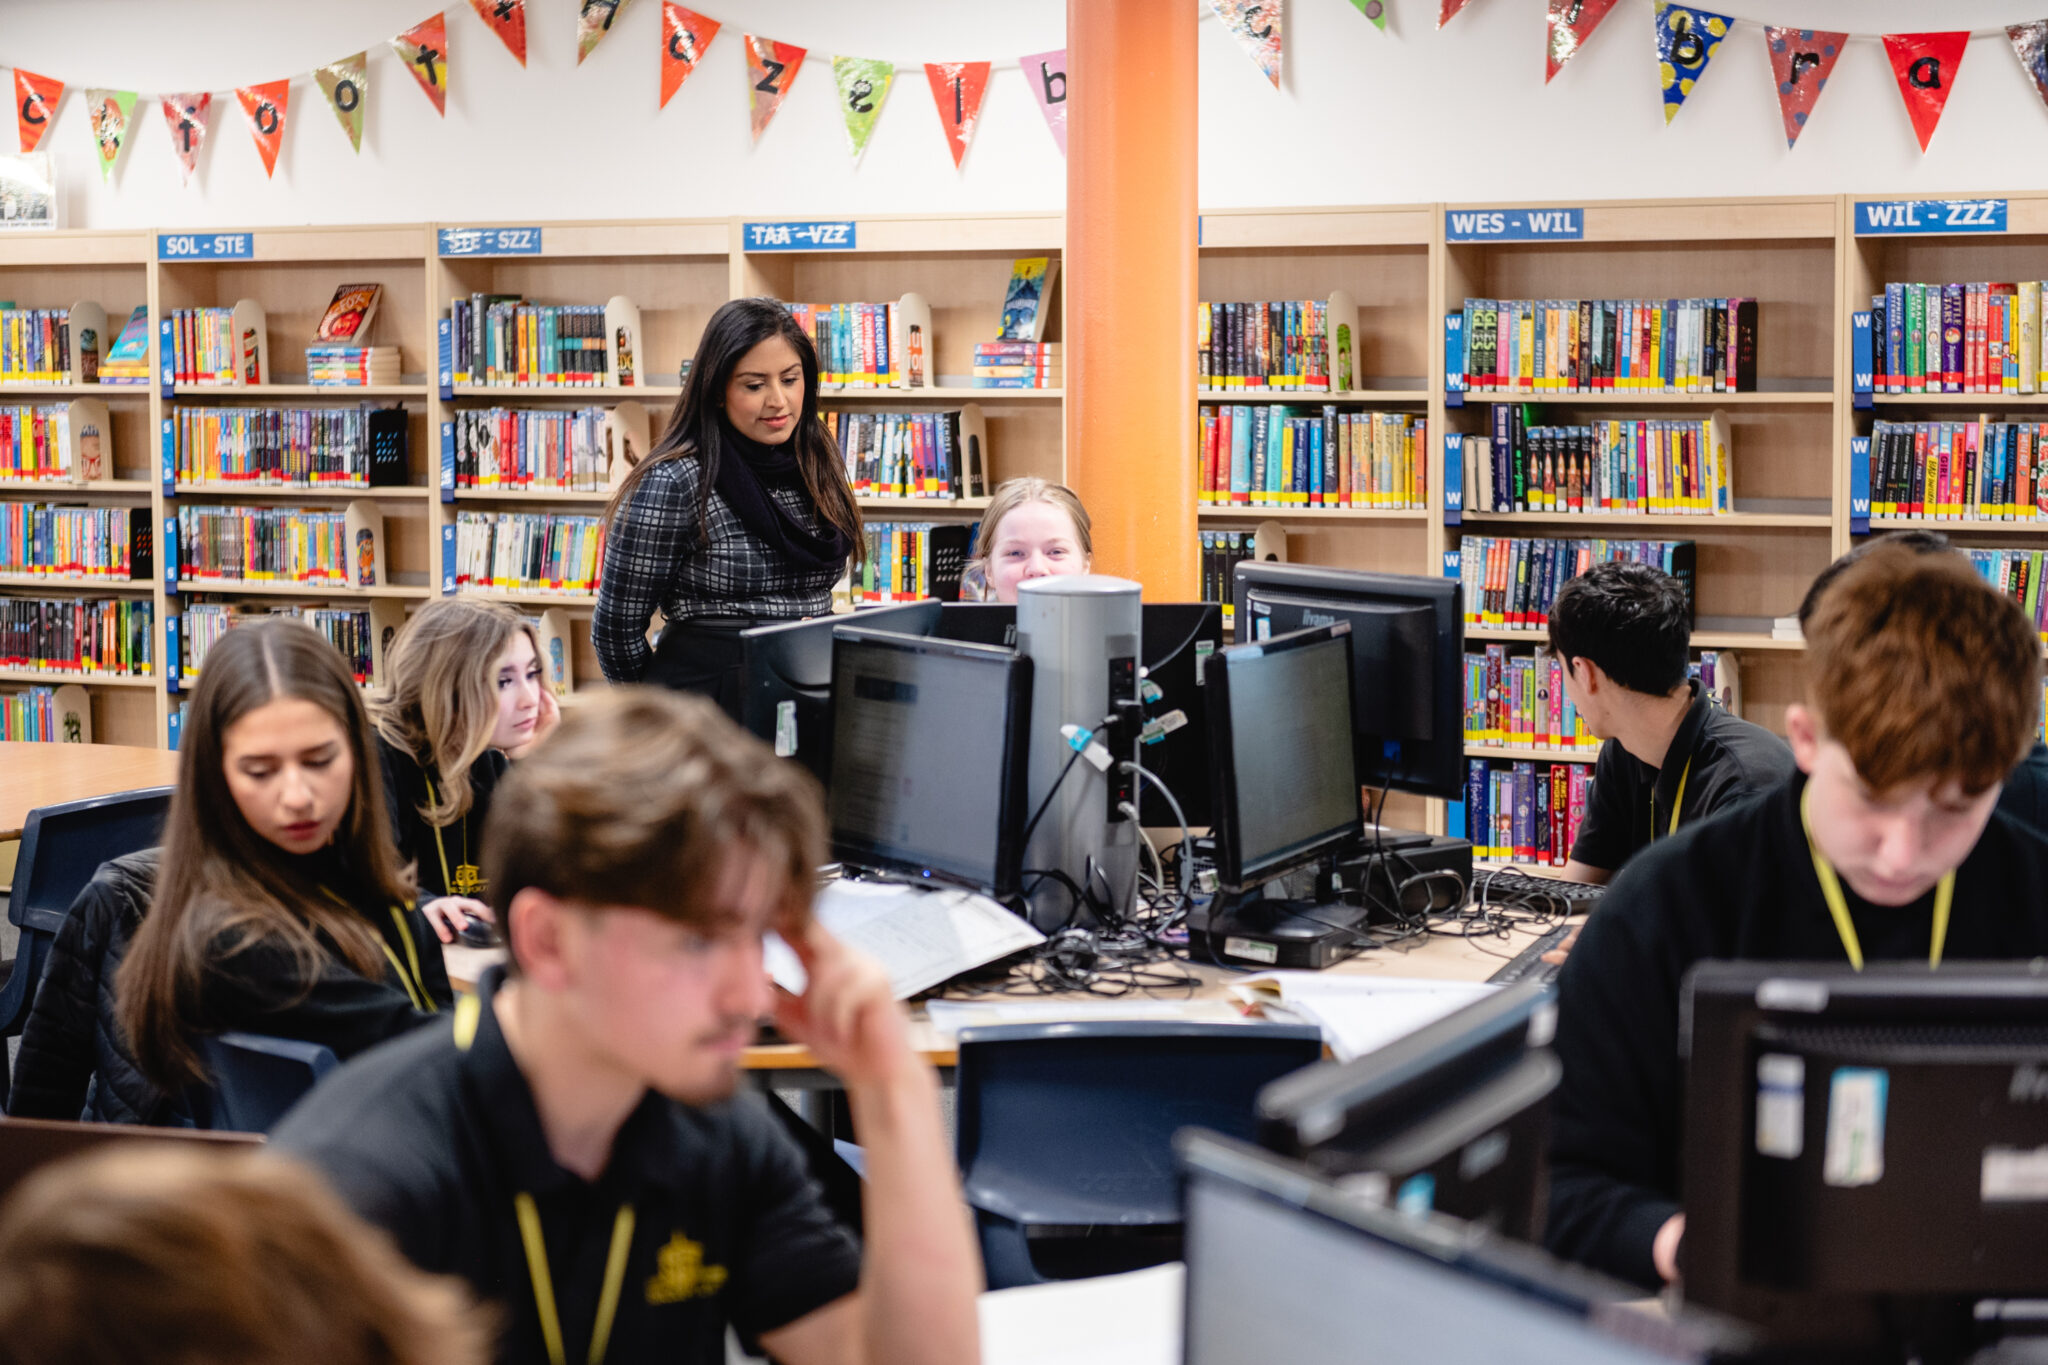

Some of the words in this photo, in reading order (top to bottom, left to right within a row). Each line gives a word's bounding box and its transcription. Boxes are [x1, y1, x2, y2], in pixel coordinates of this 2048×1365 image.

[1671, 17, 1704, 65] b
[1909, 56, 1941, 90] a
[1452, 213, 1505, 234] WES
[1528, 212, 1577, 233] WIL
[1867, 204, 1920, 227] WIL
[1945, 204, 1996, 226] ZZZ
[166, 236, 199, 255] SOL
[214, 235, 245, 254] STE
[497, 230, 532, 249] SZZ
[752, 225, 781, 245] TAA
[809, 225, 848, 244] VZZ
[1943, 296, 1953, 324] TARS
[1953, 296, 1963, 326] ITTLE
[440, 322, 449, 335] S
[1446, 317, 1462, 330] W
[1511, 310, 1520, 341] PECIALS
[1854, 314, 1870, 328] W
[863, 315, 875, 366] contagion
[875, 315, 887, 366] deception
[1535, 339, 1544, 377] IMPOSTORS
[1447, 373, 1462, 386] W
[1856, 373, 1872, 387] W
[163, 421, 170, 434] S
[443, 423, 451, 437] S
[1445, 436, 1461, 449] W
[1852, 440, 1868, 454] W
[1324, 442, 1336, 478] SPACEBOY
[1940, 456, 1949, 479] GIRL
[1446, 492, 1462, 505] W
[1853, 498, 1870, 512] W
[166, 521, 173, 533] S
[444, 527, 452, 541] S
[1444, 554, 1459, 567] W
[2008, 572, 2017, 592] FACE
[2017, 560, 2028, 588] ANGSTA
[167, 619, 174, 632] S
[1553, 779, 1561, 810] WHISKERS
